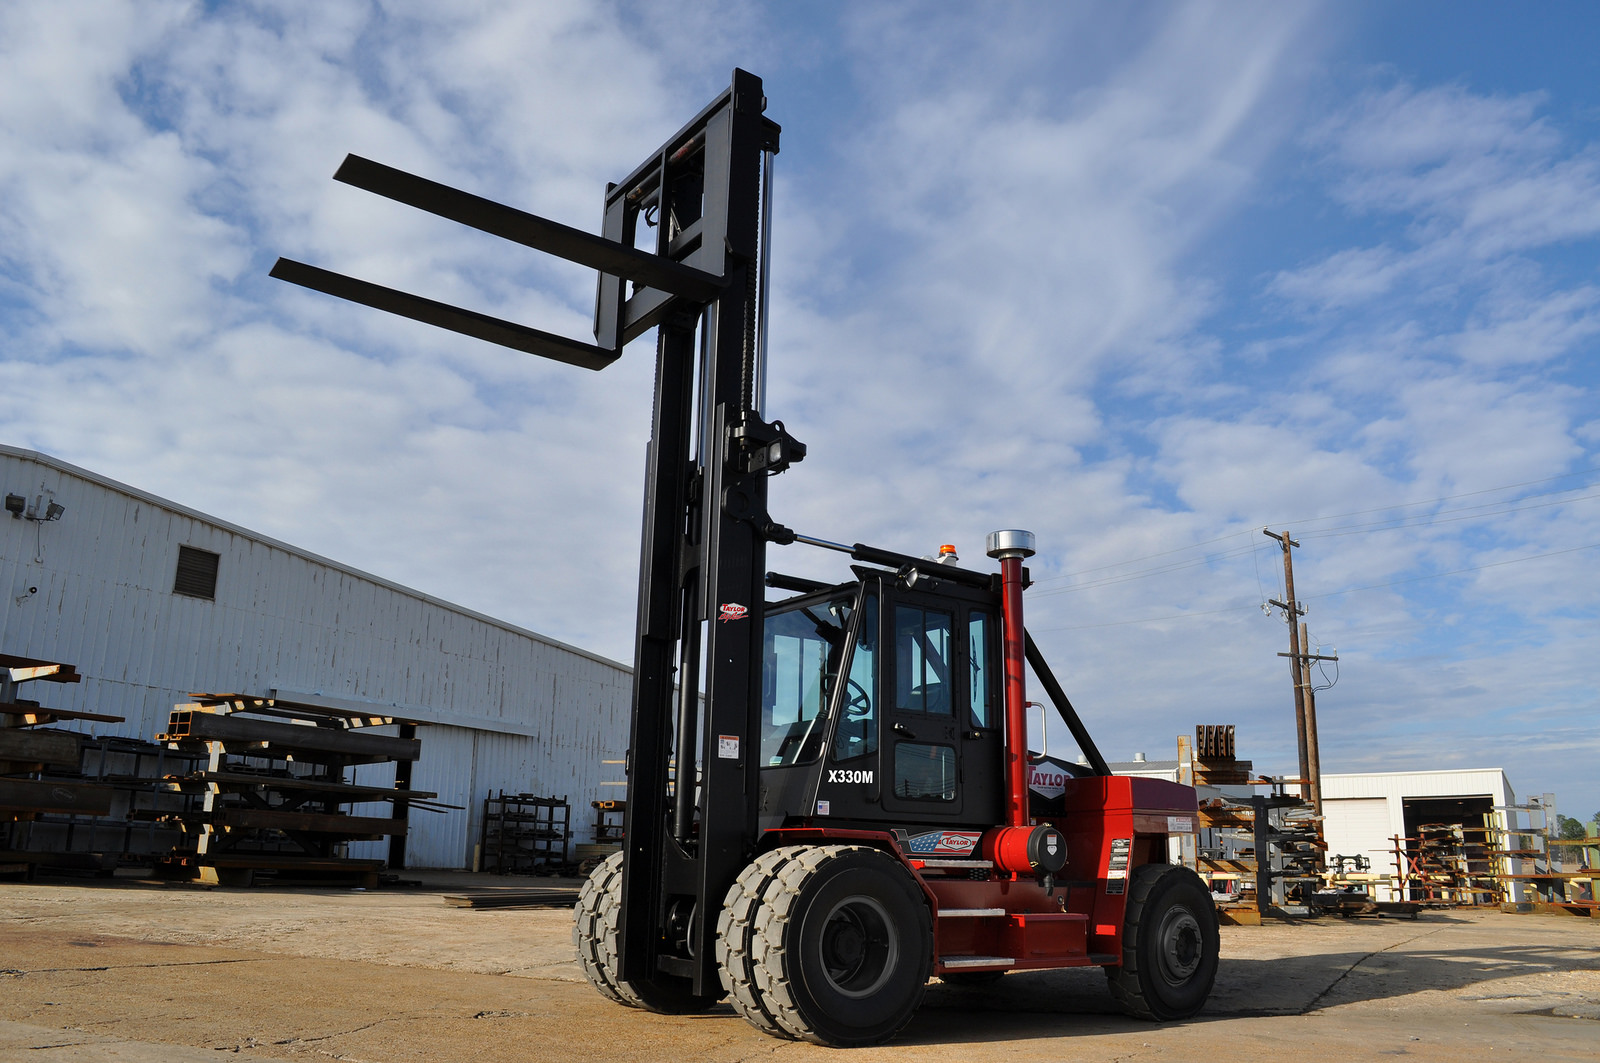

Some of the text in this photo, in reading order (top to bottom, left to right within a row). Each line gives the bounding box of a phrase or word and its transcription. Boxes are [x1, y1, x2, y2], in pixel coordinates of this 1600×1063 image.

[722, 603, 746, 612] TAYLOR
[828, 770, 873, 784] X330M
[945, 837, 969, 846] TAYLOR
